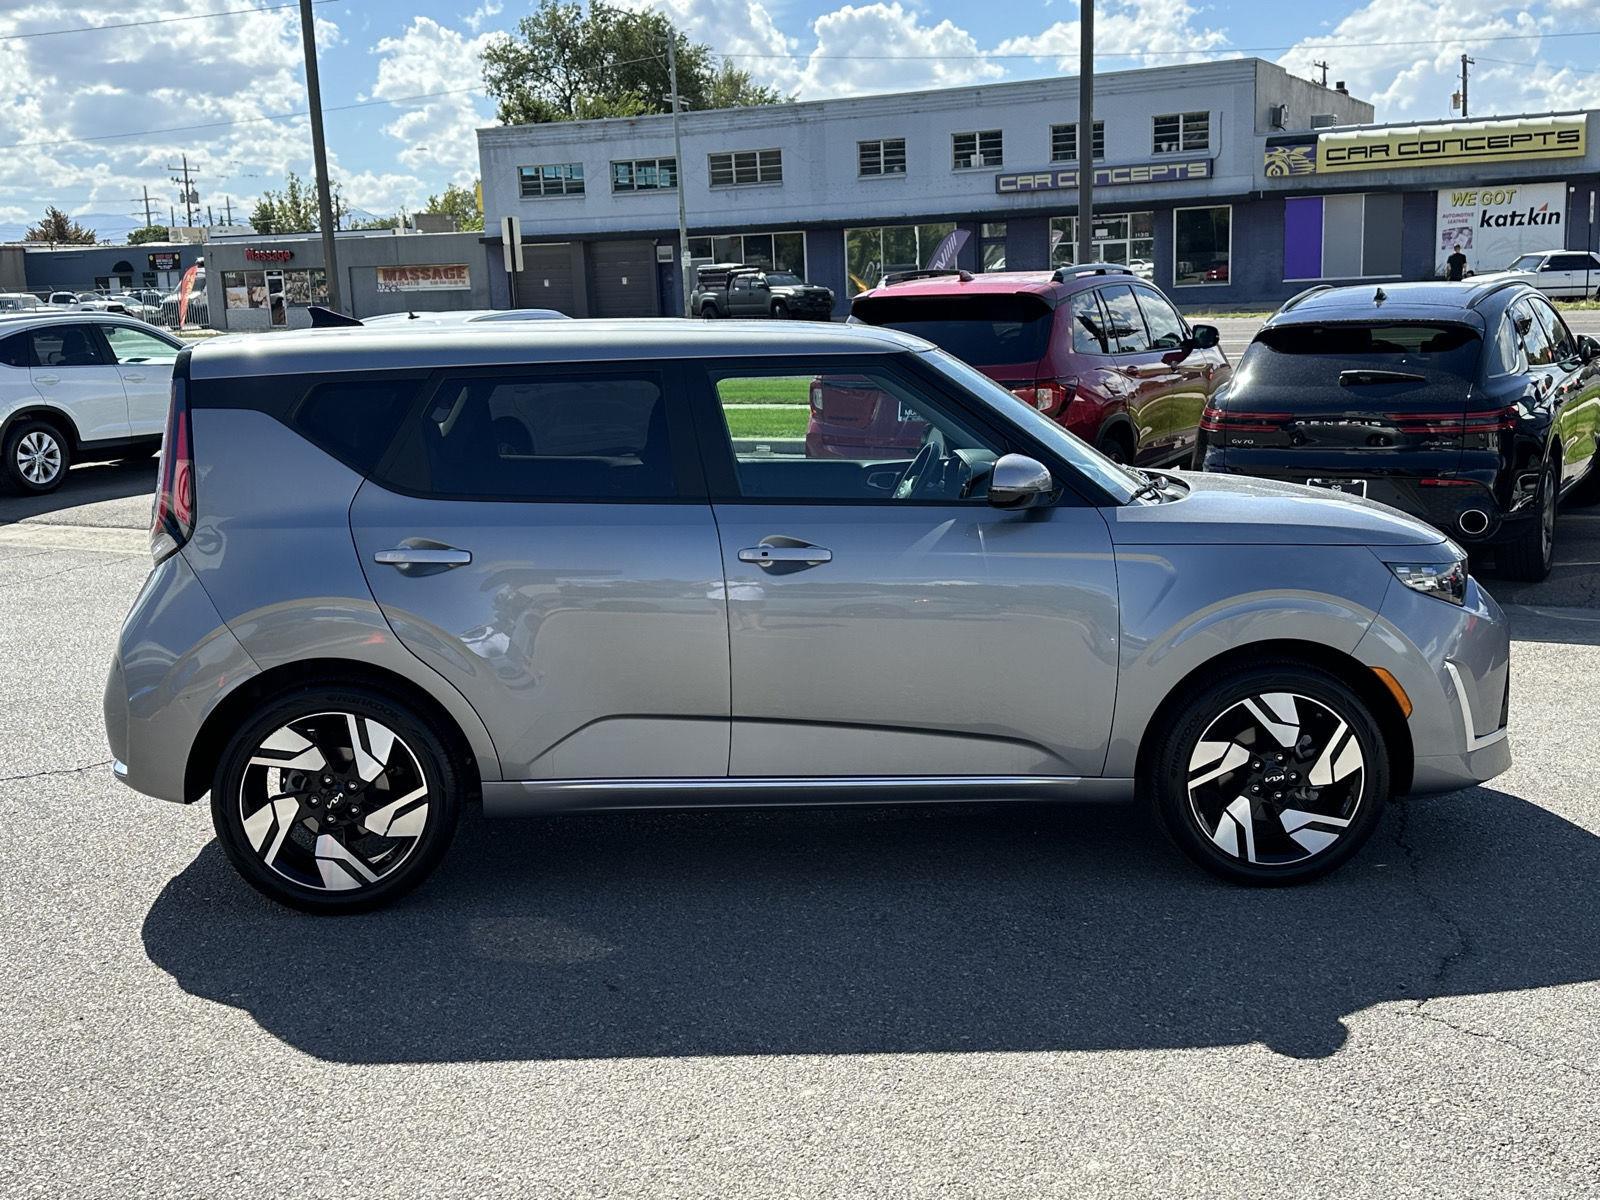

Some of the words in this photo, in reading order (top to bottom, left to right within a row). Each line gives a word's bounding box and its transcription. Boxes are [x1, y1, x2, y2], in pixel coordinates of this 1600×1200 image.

[1326, 143, 1390, 161] CAR
[1398, 129, 1580, 156] CONCEPTS
[999, 174, 1053, 191] CAR
[1057, 162, 1207, 187] CNCEPTS
[1452, 191, 1478, 207] WE
[1480, 189, 1516, 206] GOT
[1480, 203, 1561, 228] katzkin
[245, 247, 291, 262] Massage
[382, 266, 466, 281] MASSAGE
